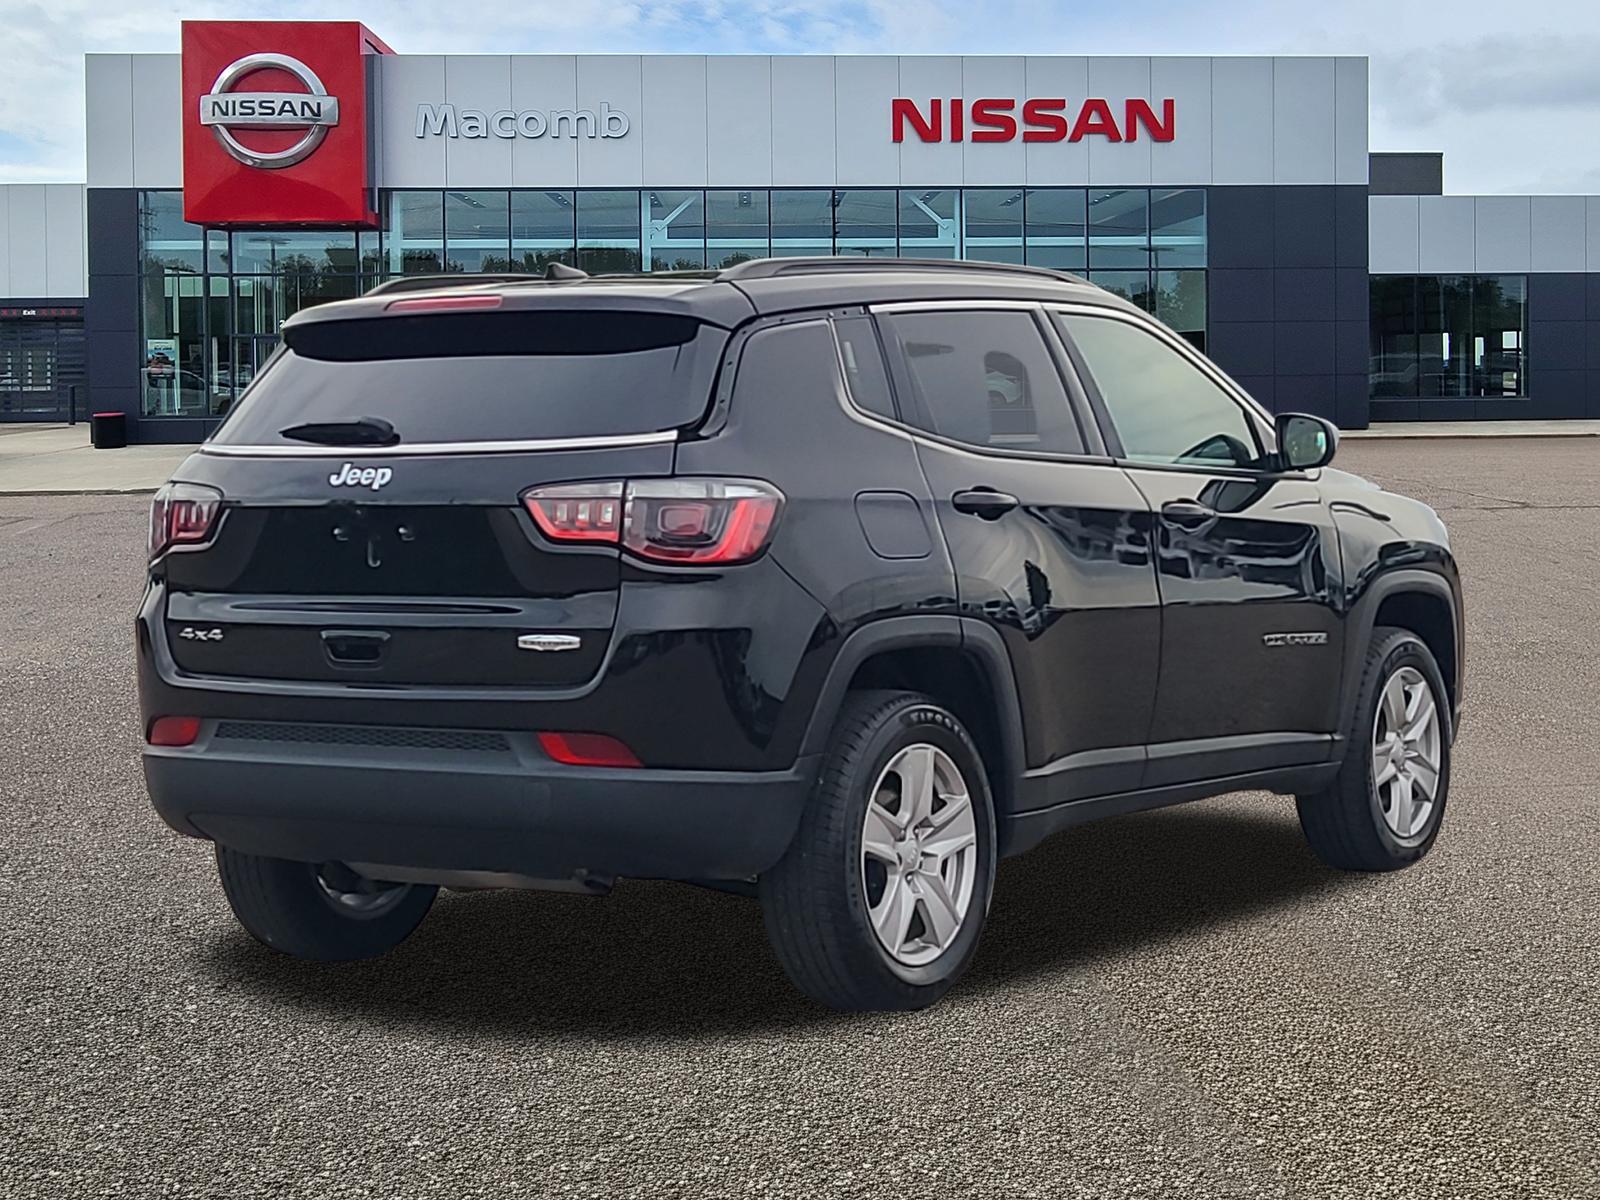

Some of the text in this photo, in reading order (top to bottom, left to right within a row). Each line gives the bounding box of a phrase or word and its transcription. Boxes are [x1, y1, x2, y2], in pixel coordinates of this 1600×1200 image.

[212, 100, 322, 117] NISSAN
[415, 102, 630, 138] Macomb
[892, 98, 1175, 142] NISSAN
[329, 463, 393, 490] Jeep
[179, 627, 224, 641] 4x4
